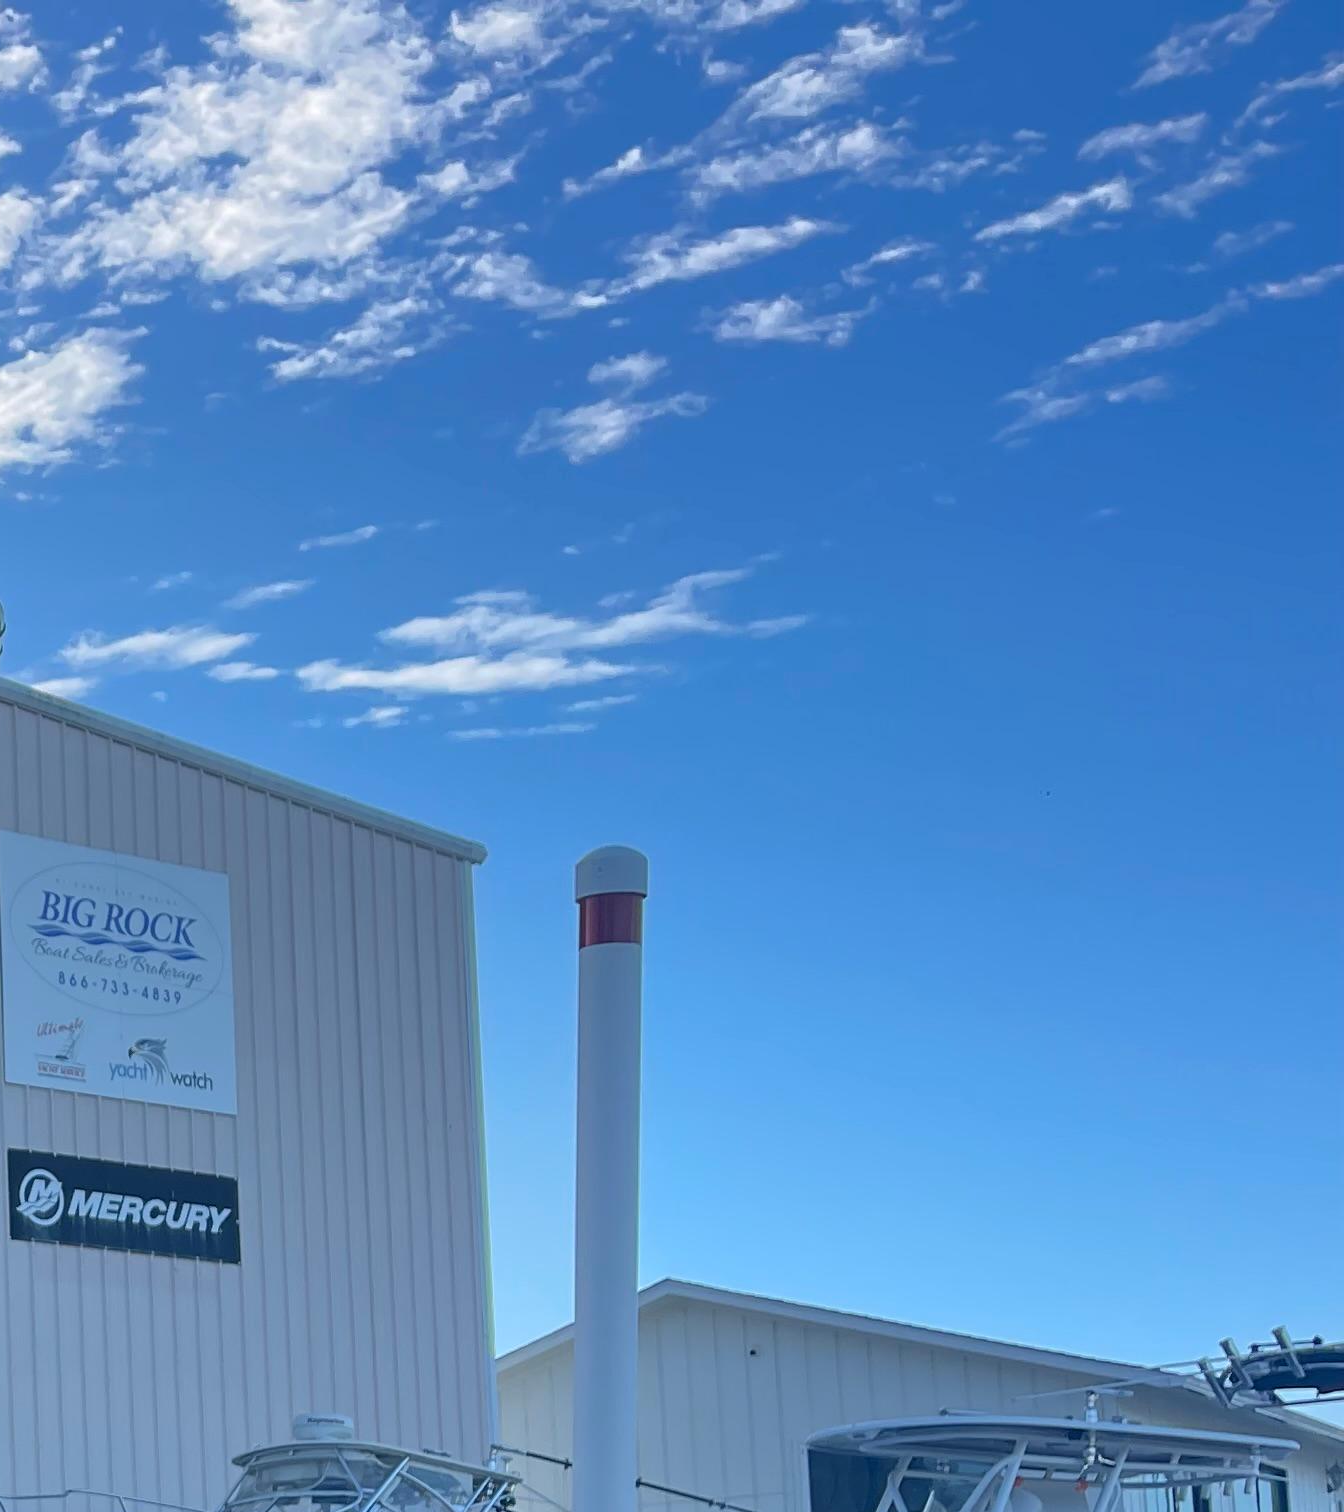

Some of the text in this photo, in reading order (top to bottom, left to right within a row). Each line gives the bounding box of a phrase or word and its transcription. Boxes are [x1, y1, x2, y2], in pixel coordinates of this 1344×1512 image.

[37, 890, 97, 929] BIG
[101, 902, 198, 948] ROCK
[31, 937, 204, 988] Boat Sales & Brokerage
[108, 1061, 148, 1081] yacht
[171, 1069, 214, 1091] watch
[67, 1188, 232, 1234] MERCURY
